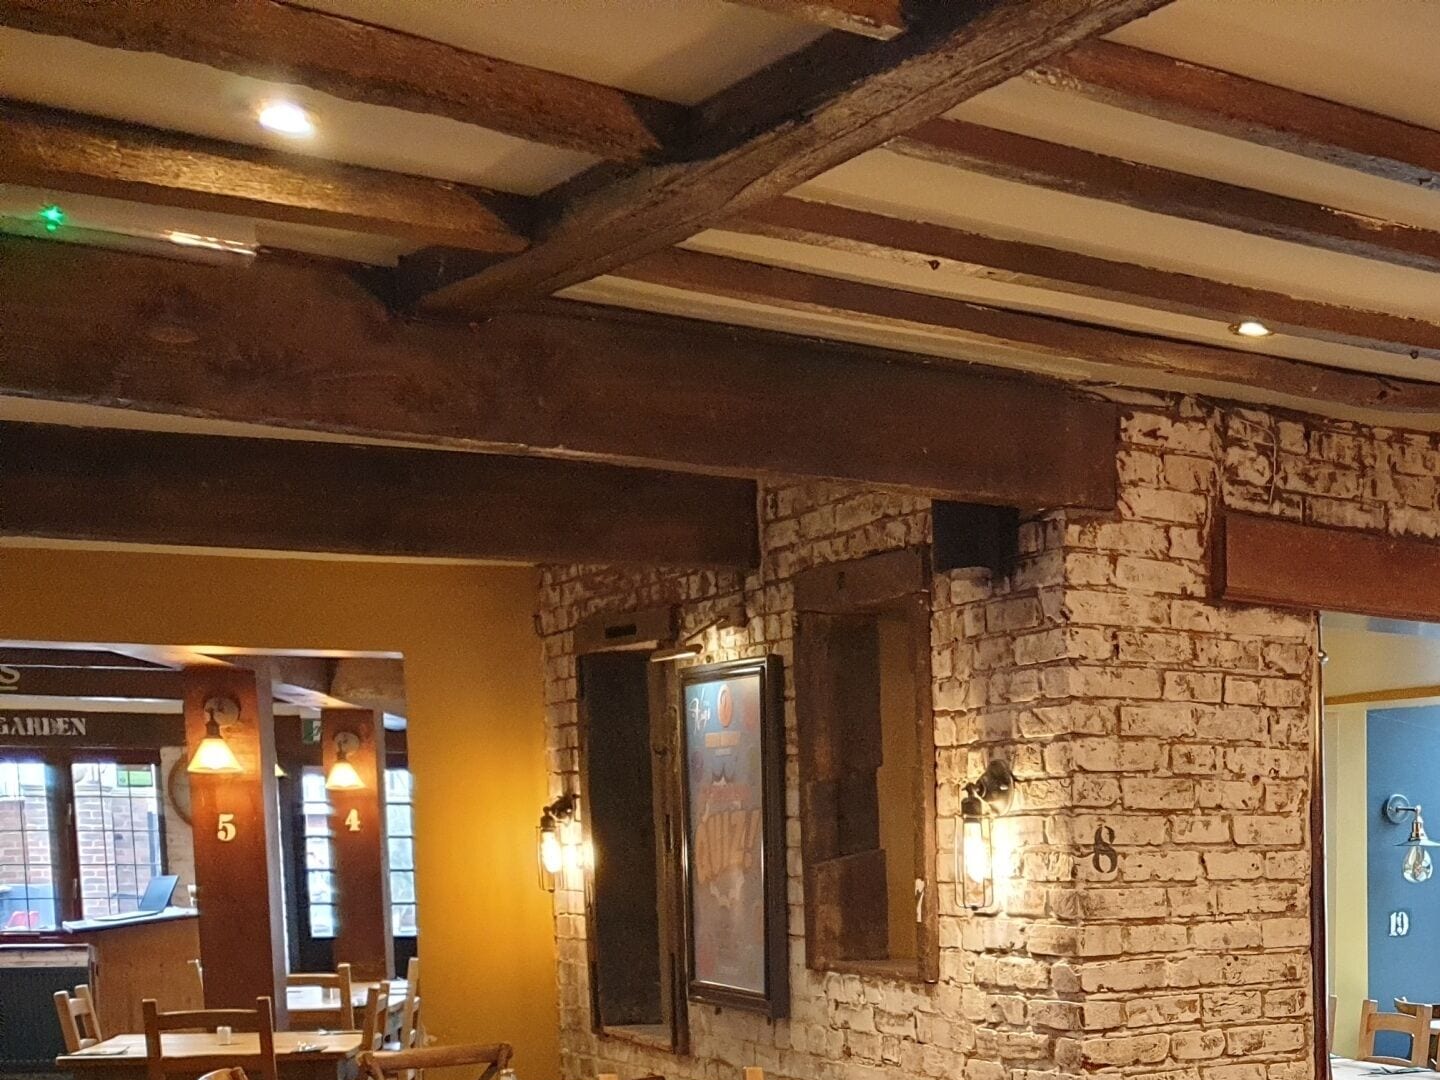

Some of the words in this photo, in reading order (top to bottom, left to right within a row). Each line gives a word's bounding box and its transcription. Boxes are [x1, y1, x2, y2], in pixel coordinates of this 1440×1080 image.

[217, 813, 237, 842] 5
[344, 808, 361, 832] 4
[1092, 823, 1118, 874] 8
